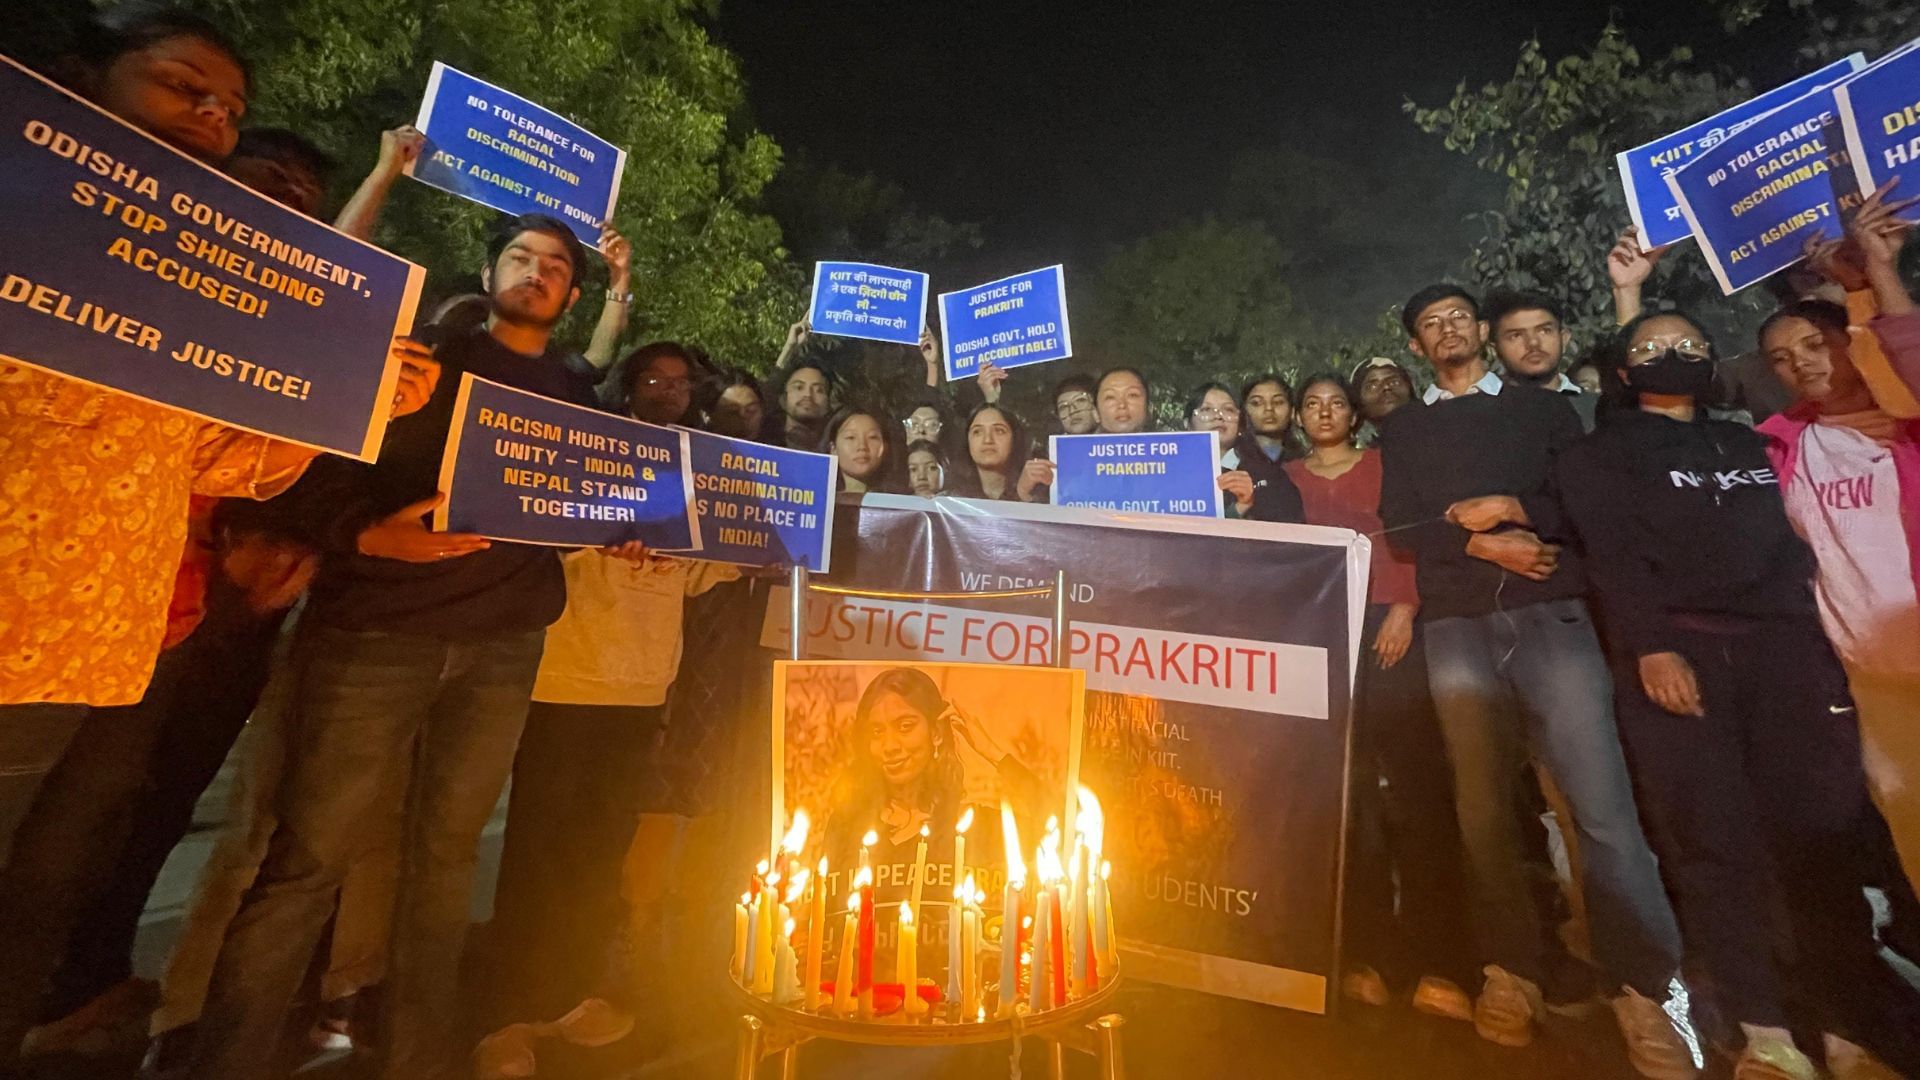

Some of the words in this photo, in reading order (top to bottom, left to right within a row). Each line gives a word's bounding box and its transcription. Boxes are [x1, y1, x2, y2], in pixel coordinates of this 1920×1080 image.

[466, 95, 488, 111] NO
[493, 105, 570, 148] TOLERANCE
[572, 143, 596, 163] FOR
[507, 128, 555, 159] RACIAL
[466, 127, 580, 186] DISCRIMINATION!
[1650, 141, 1694, 167] KIIT
[1707, 168, 1727, 187] NO
[1727, 111, 1834, 173] TOLERANCE
[1755, 139, 1827, 179] RACIAL
[432, 150, 465, 171] ACT
[468, 164, 532, 198] AGAINST
[535, 191, 561, 210] KIIT
[23, 120, 159, 201] ODISHA
[171, 192, 372, 299] GOVERNMENT,
[71, 181, 167, 234] STOP
[176, 230, 325, 308] SHIELDING
[1730, 240, 1757, 263] ACT
[1760, 202, 1830, 247] AGAINST
[106, 237, 269, 319] ACCUSED!
[829, 271, 852, 281] KIIT
[968, 286, 1008, 307] JUSTICE
[1011, 280, 1032, 294] FOR
[0, 274, 162, 352] DELIVER
[171, 341, 312, 400] JUSTICE!
[955, 336, 990, 354] ODISHA
[1027, 322, 1056, 337] HOLD
[955, 356, 975, 369] KIIT
[978, 338, 1057, 364] ACCOUNTABLE!
[478, 407, 562, 442] RACISM
[568, 429, 630, 455] HURTS
[636, 444, 671, 463] OUR
[1088, 443, 1146, 457] JUSTICE
[1150, 442, 1178, 456] FOR
[495, 439, 559, 466] UNITY
[585, 456, 635, 479] INDIA
[642, 467, 656, 481] &
[721, 452, 780, 477] RACIAL
[1096, 462, 1166, 476] PRAKRITI!
[503, 467, 574, 494] NEPAL
[580, 480, 648, 502] STAND
[692, 471, 814, 506] SCRIMINATION
[1669, 468, 1779, 490] NKE
[519, 495, 635, 522] TOGETHER!
[714, 501, 738, 519] NO
[743, 504, 795, 527] PLACE
[800, 513, 816, 529] IN
[1169, 499, 1206, 513] HOLD
[719, 527, 769, 549] INDIA!
[778, 600, 948, 653] USTICE
[961, 617, 1052, 665] FOR
[1069, 629, 1277, 695] PRAKRITI
